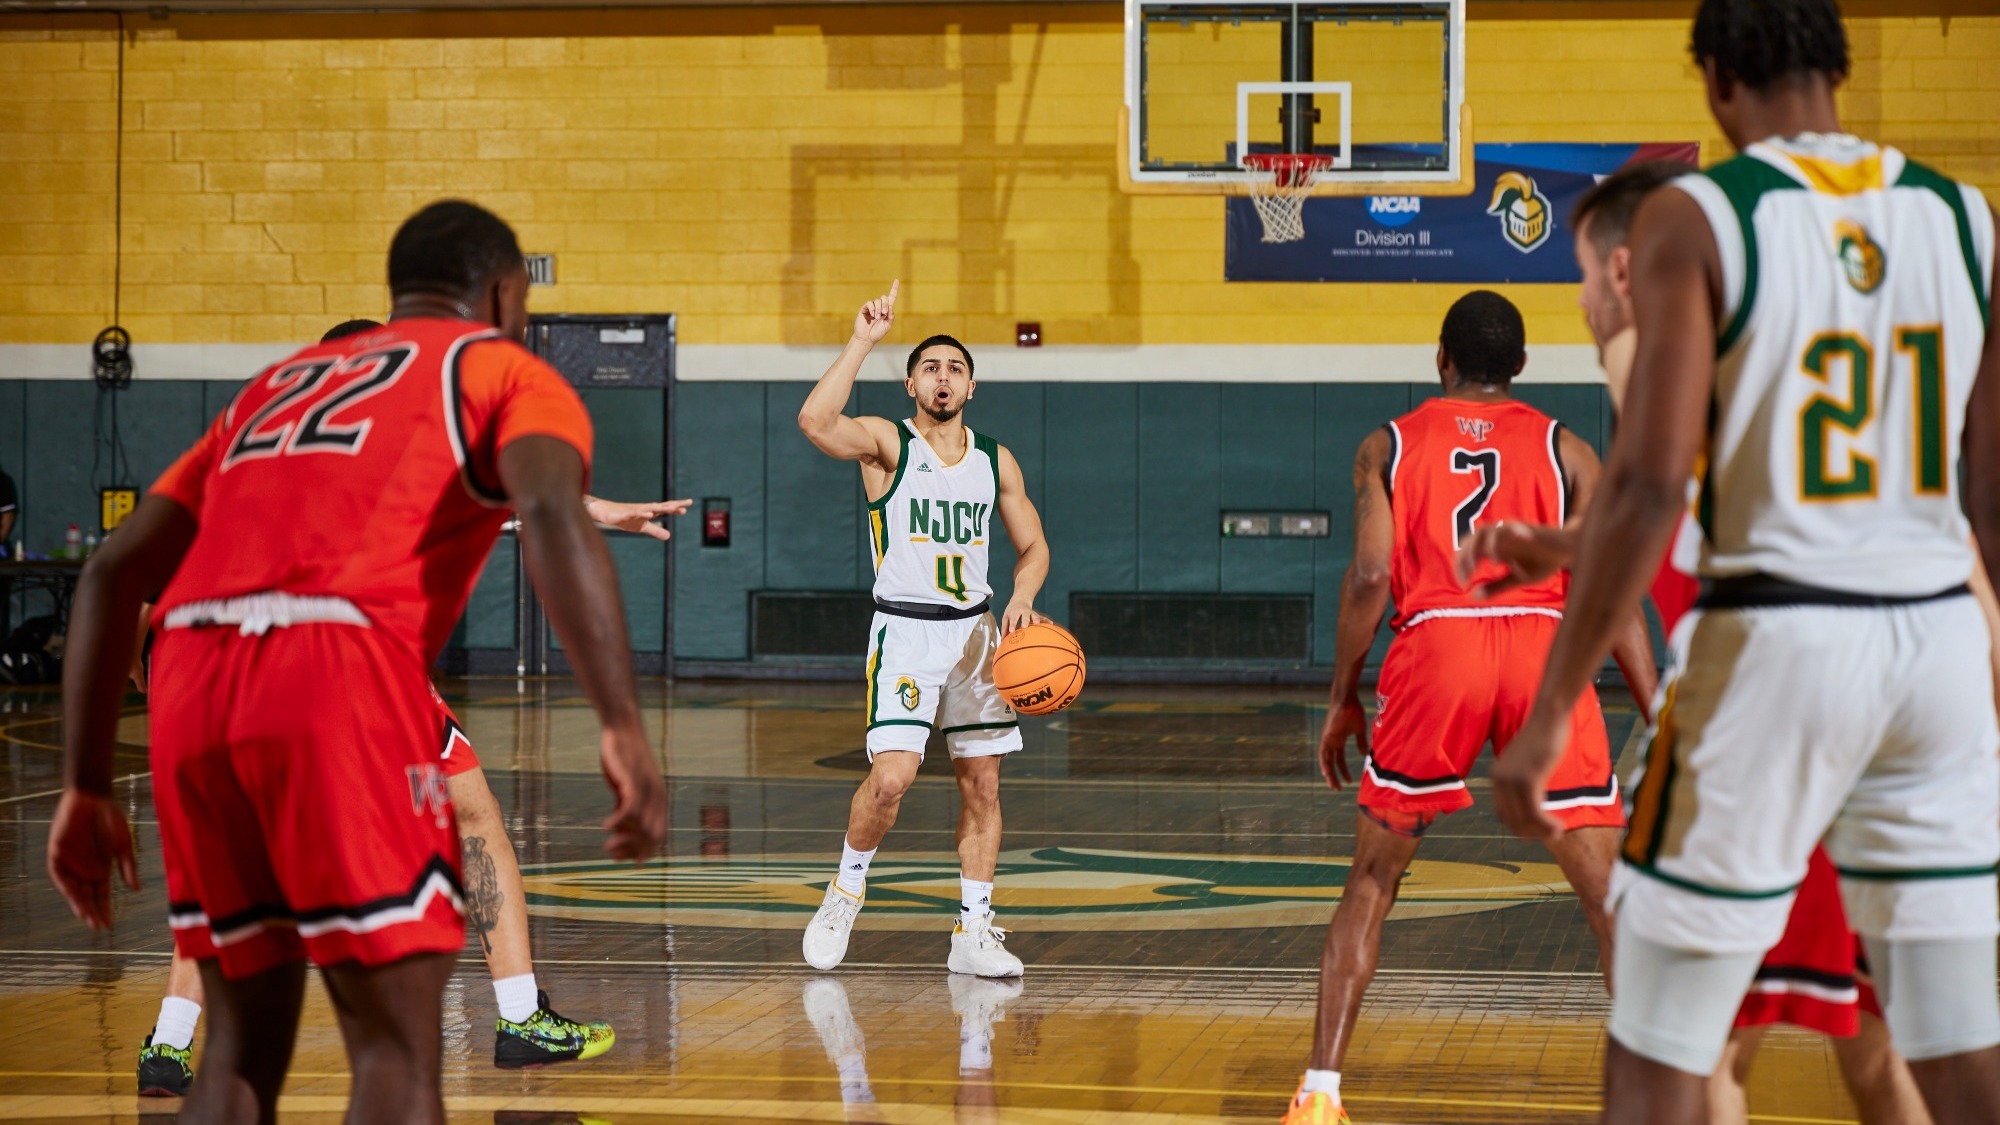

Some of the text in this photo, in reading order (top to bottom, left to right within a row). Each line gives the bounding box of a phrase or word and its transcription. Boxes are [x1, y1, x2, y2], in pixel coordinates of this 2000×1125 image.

[1370, 196, 1421, 213] NCAA
[1356, 229, 1430, 246] Division III
[1332, 249, 1454, 257] DISCOVER DEVELOP DEDICATE
[524, 257, 547, 283] XIT
[220, 341, 419, 474] 22
[1797, 322, 1949, 504] 21
[1455, 415, 1494, 442] WP
[1450, 448, 1500, 551] 7
[910, 498, 988, 544] NJCU
[936, 554, 971, 603] 4
[1010, 686, 1053, 708] NCAA
